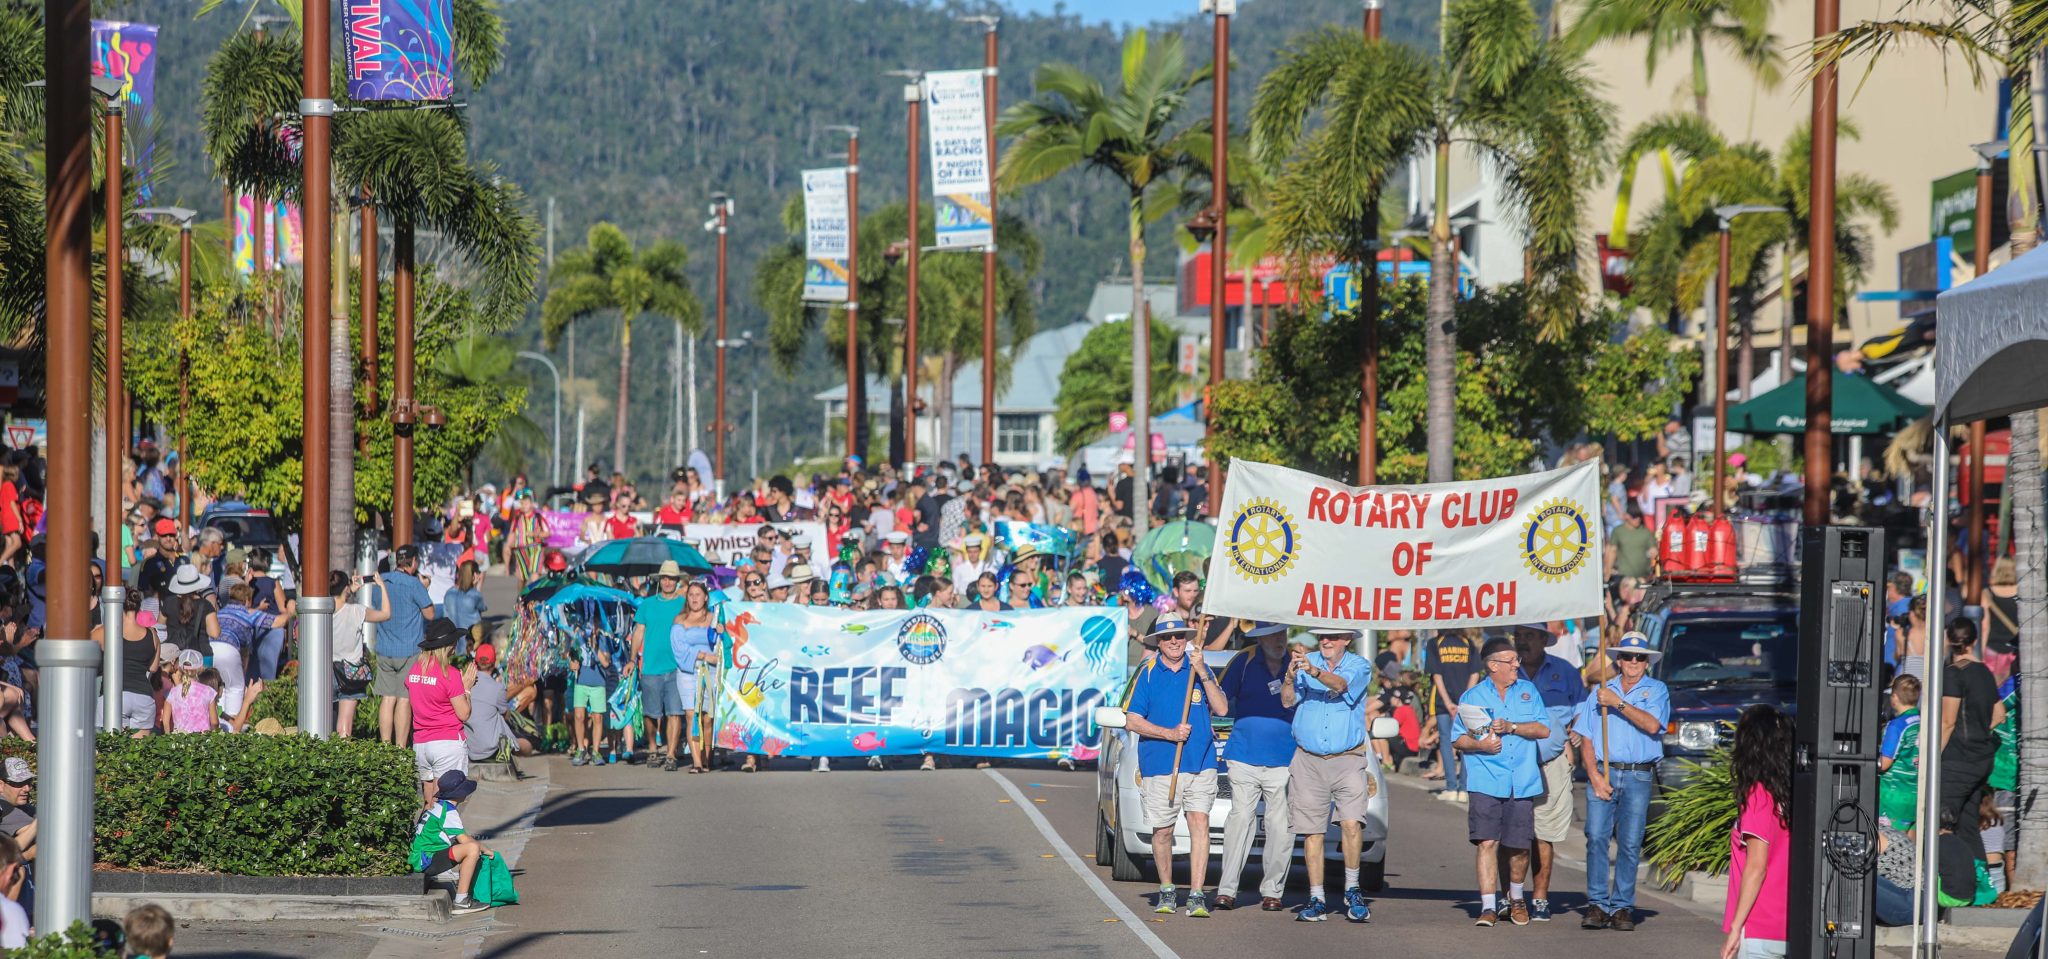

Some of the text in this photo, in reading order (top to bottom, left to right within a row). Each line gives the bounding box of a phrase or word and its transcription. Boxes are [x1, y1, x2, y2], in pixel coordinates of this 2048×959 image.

[344, 18, 349, 31] OF
[345, 31, 354, 80] COMMERCE
[936, 146, 983, 156] RACING
[946, 160, 984, 168] NIGHTS
[938, 169, 983, 178] OF FREE
[1250, 505, 1282, 520] ROTARY
[1307, 486, 1519, 529] ROTARY CLUB
[1540, 505, 1573, 520] ROTARY
[1233, 550, 1288, 575] INTERNATIONAL
[1391, 541, 1433, 577] OF
[1531, 549, 1586, 575] INTERNATIONAL
[1296, 580, 1517, 621] AIRLIE BEACH
[902, 615, 943, 632] CHRISTIAN
[902, 649, 941, 664] COLLEGE
[1439, 646, 1469, 655] MARINE
[1440, 655, 1469, 664] RESCUE
[421, 675, 437, 686] TEAM
[737, 658, 907, 725] the REEF
[945, 688, 1106, 749] MAGIC
